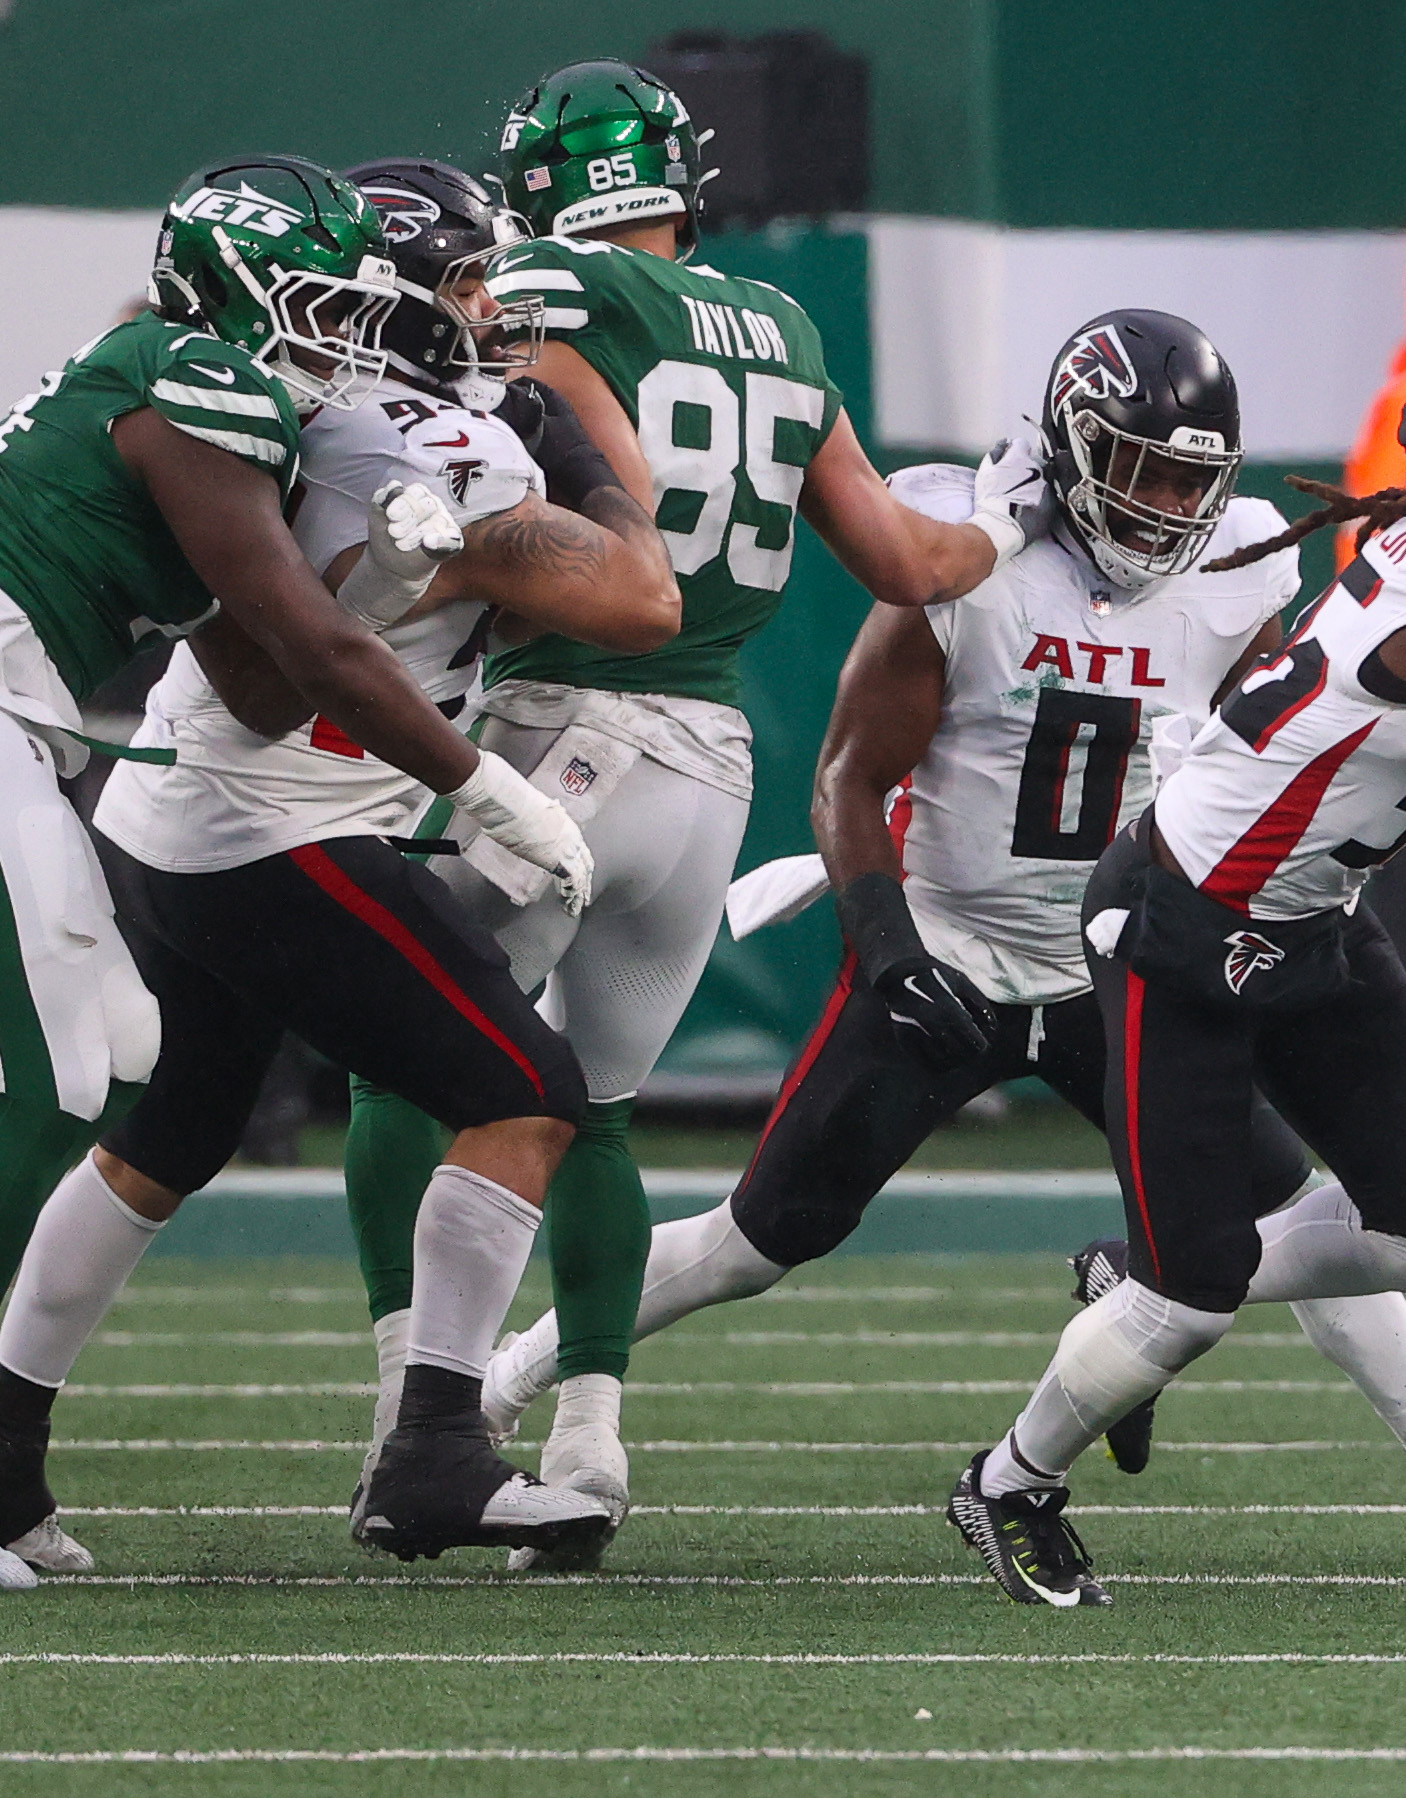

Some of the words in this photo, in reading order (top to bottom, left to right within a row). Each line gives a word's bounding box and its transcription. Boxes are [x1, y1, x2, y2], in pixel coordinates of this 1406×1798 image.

[587, 153, 638, 192] 85
[176, 180, 306, 238] JETS
[561, 206, 608, 228] NEW
[615, 195, 671, 214] YORK
[376, 263, 393, 276] NY
[680, 294, 789, 366] TAYLOR
[1187, 434, 1216, 448] ATL
[637, 359, 826, 593] 85
[1020, 631, 1167, 688] ATL
[562, 768, 586, 794] NFL
[1010, 687, 1142, 862] 0
